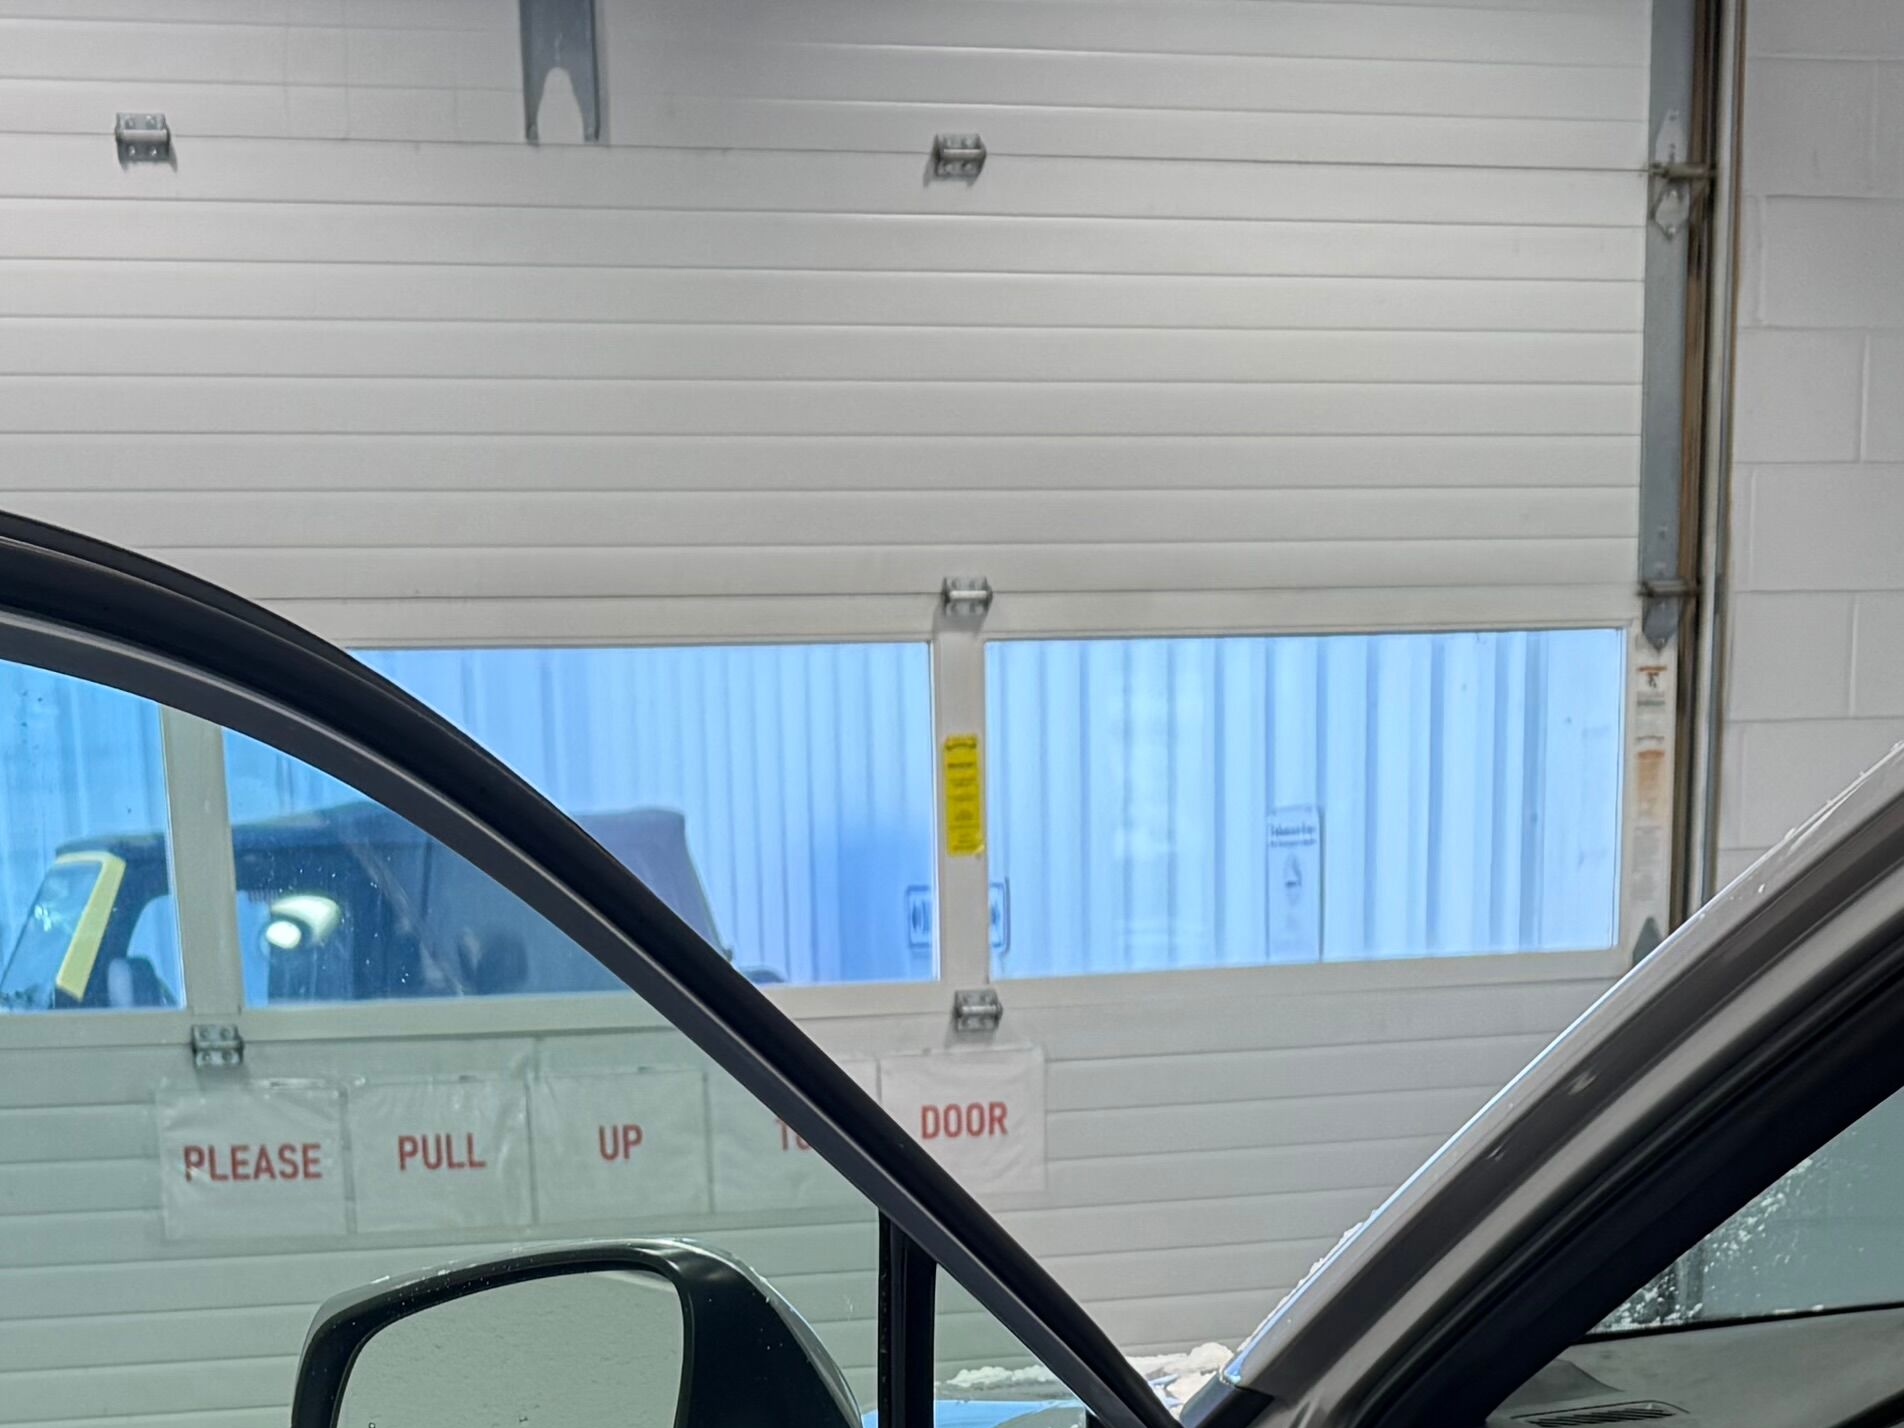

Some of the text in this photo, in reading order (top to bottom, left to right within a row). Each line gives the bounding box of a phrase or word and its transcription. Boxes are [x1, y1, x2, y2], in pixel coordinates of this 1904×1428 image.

[183, 1142, 323, 1182] PLEASE
[397, 1132, 487, 1171] PULL
[598, 1123, 643, 1162] UP
[920, 1101, 1009, 1140] DOOR
